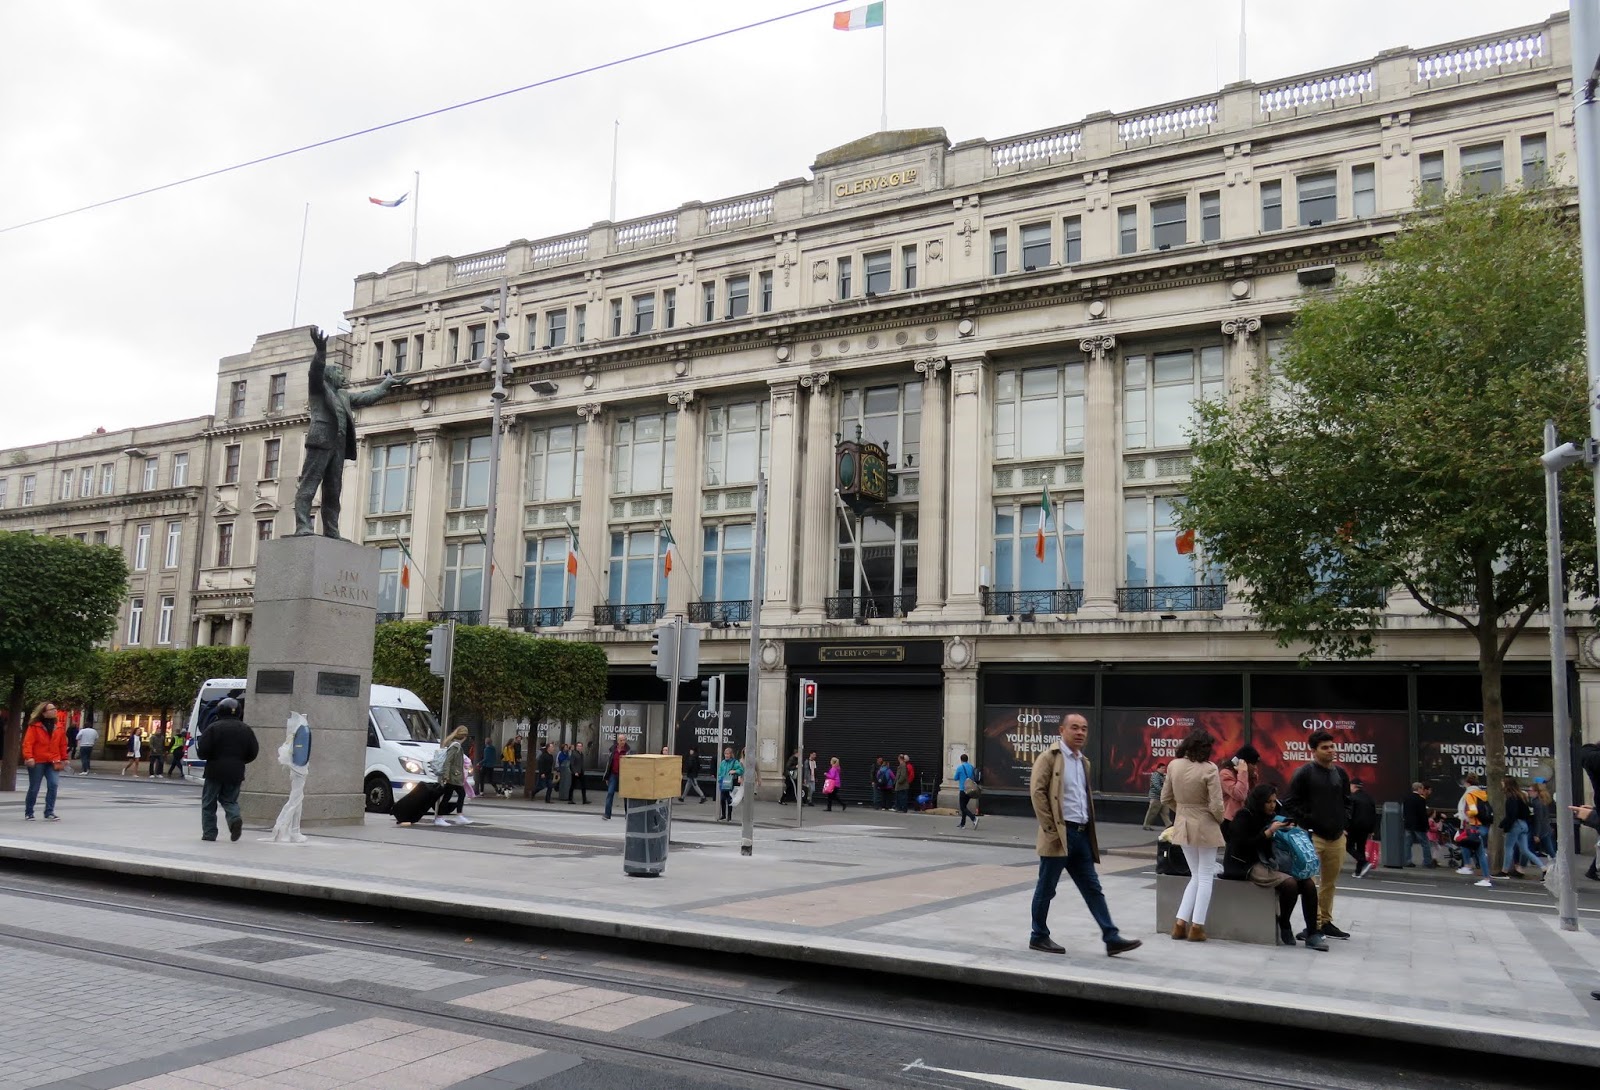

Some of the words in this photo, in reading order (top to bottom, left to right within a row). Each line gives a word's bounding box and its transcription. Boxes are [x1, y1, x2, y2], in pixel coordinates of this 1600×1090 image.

[836, 177, 881, 197] CLERY
[880, 176, 889, 188] &
[337, 570, 359, 582] JIM
[324, 582, 369, 600] LARKIN
[614, 726, 627, 734] CAN
[694, 728, 719, 736] HISTOR
[1464, 722, 1484, 736] GP
[1006, 734, 1024, 743] YOU
[1024, 734, 1042, 744] CAN
[1043, 735, 1062, 744] SME
[1151, 738, 1184, 748] HISTO
[1013, 744, 1030, 752] THE
[1030, 744, 1050, 752] GUN
[1285, 741, 1306, 750] YOU
[1440, 744, 1486, 754] HISTOR
[1510, 746, 1550, 757] CLEAR
[1152, 748, 1166, 757] SO
[1283, 750, 1314, 760] SMELL
[1338, 754, 1378, 764] SMOKE
[1452, 755, 1486, 765] YOU'R
[1515, 758, 1539, 768] THE
[1461, 766, 1488, 776] FRO
